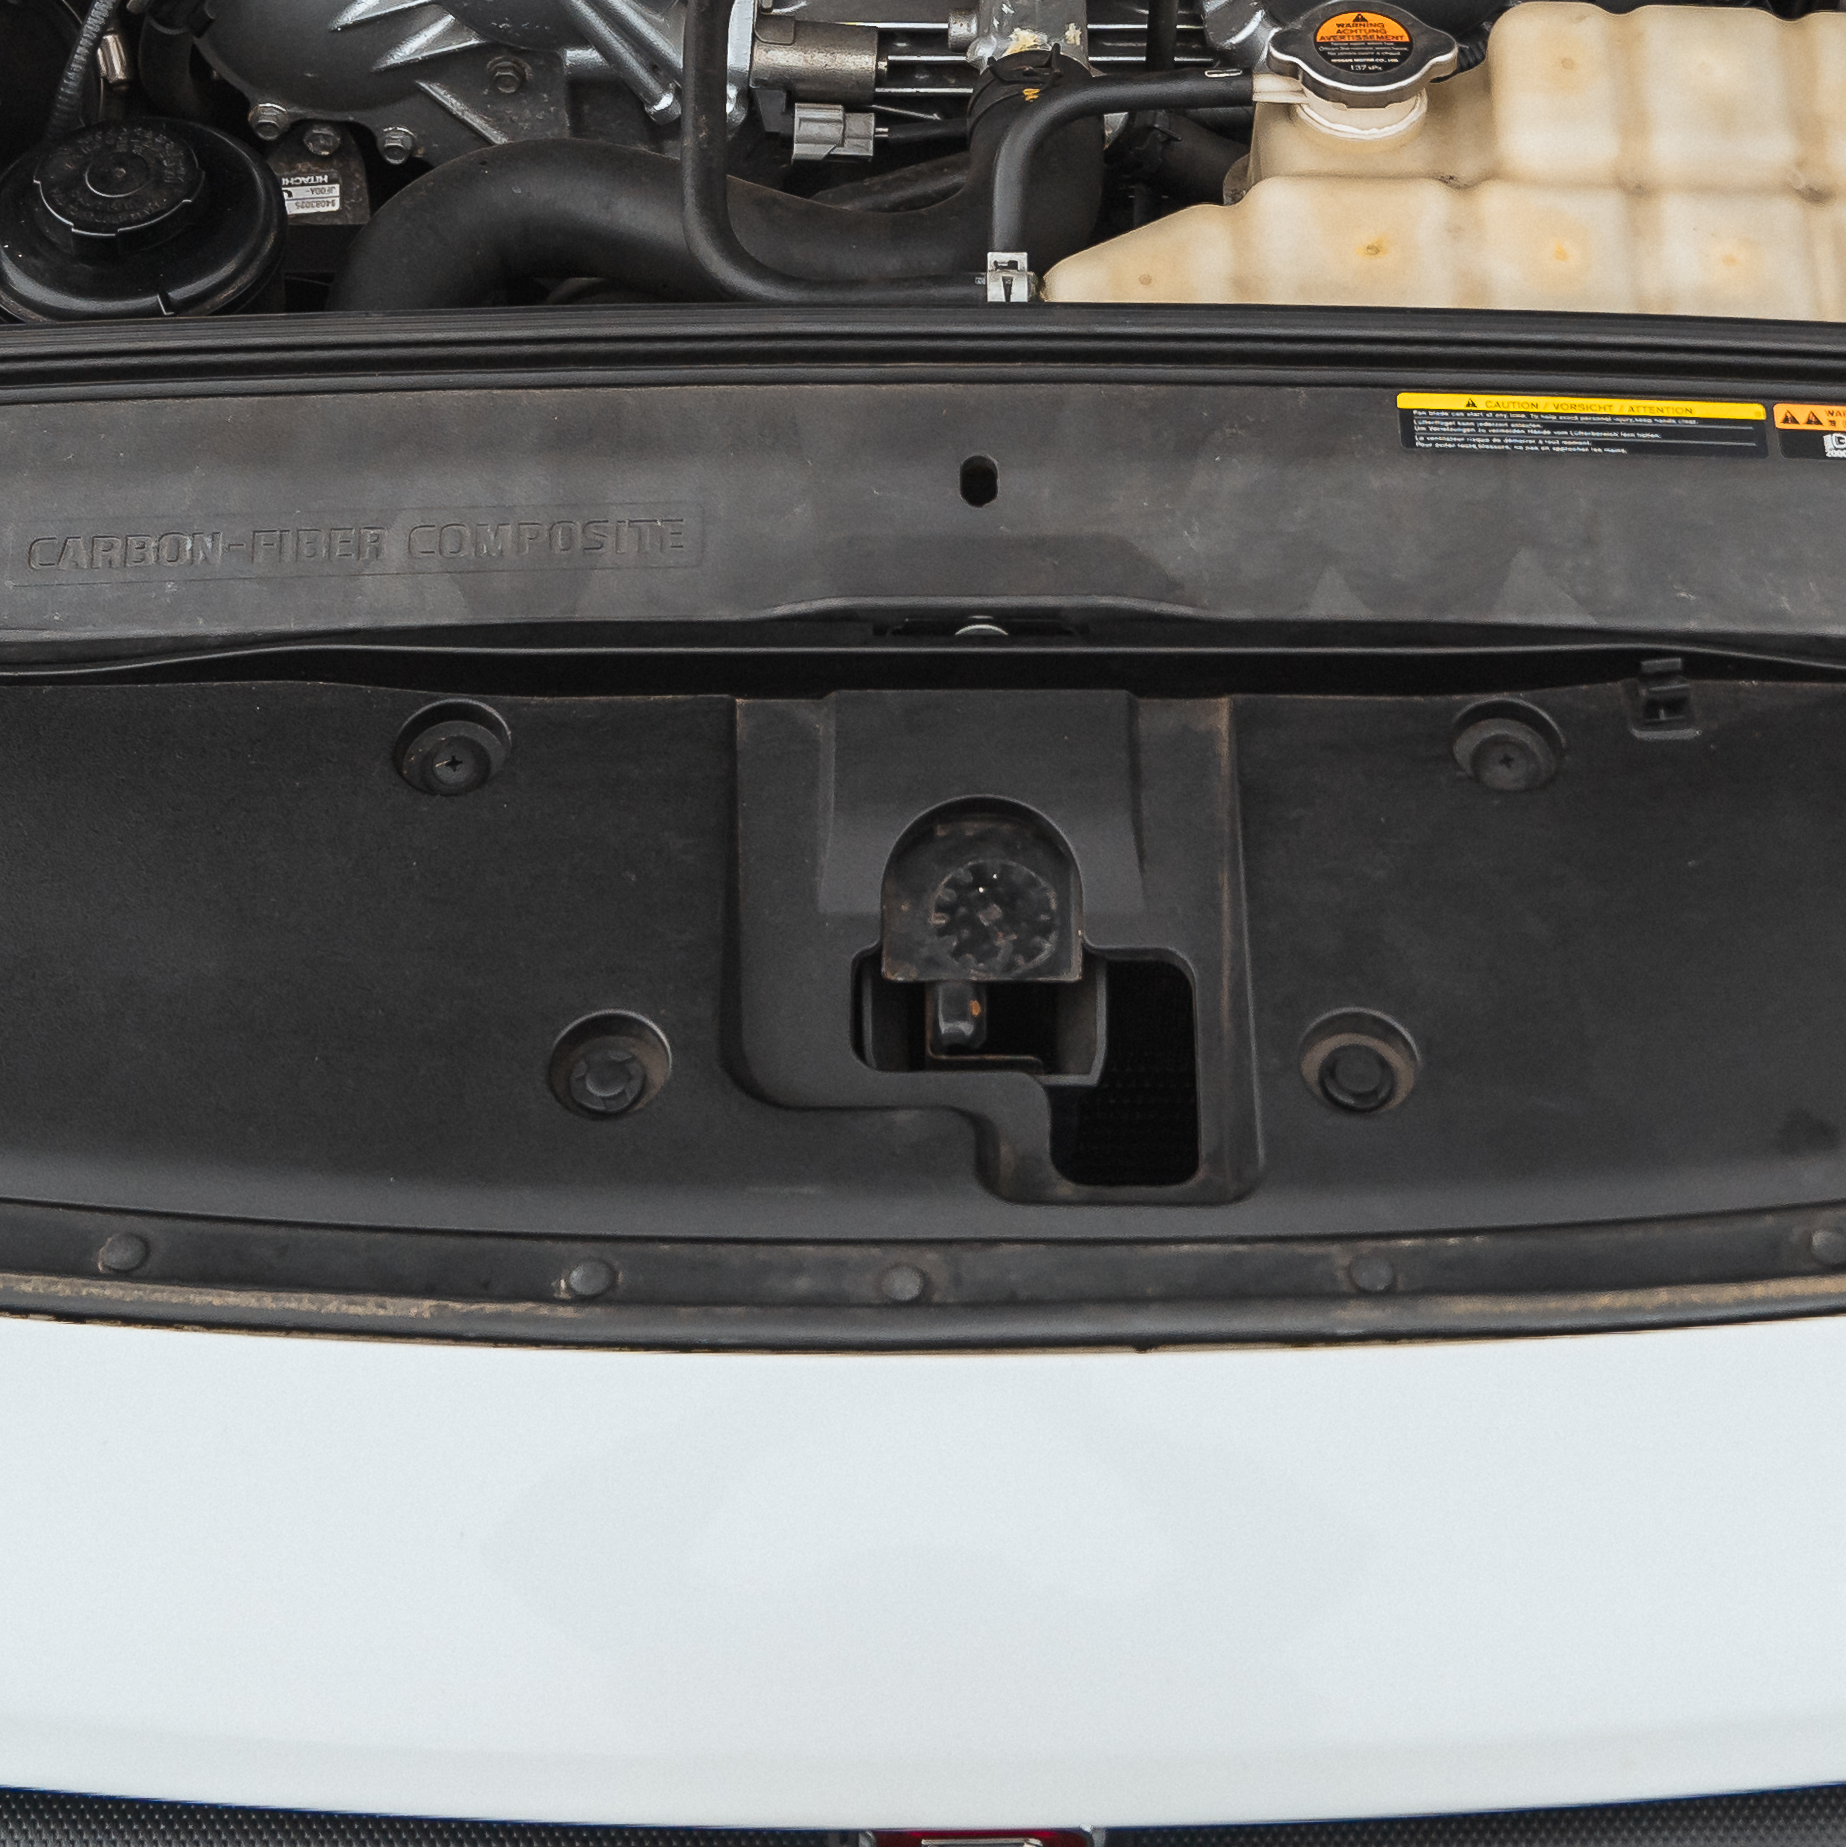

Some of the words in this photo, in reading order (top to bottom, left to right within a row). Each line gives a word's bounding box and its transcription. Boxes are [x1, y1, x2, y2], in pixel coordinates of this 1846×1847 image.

[282, 175, 328, 185] HITACHI
[1485, 400, 1539, 410] CAUTION
[1552, 401, 1614, 413] VORSICHT
[1627, 404, 1694, 415] ATTENTION
[407, 517, 687, 559] COMPOSITE
